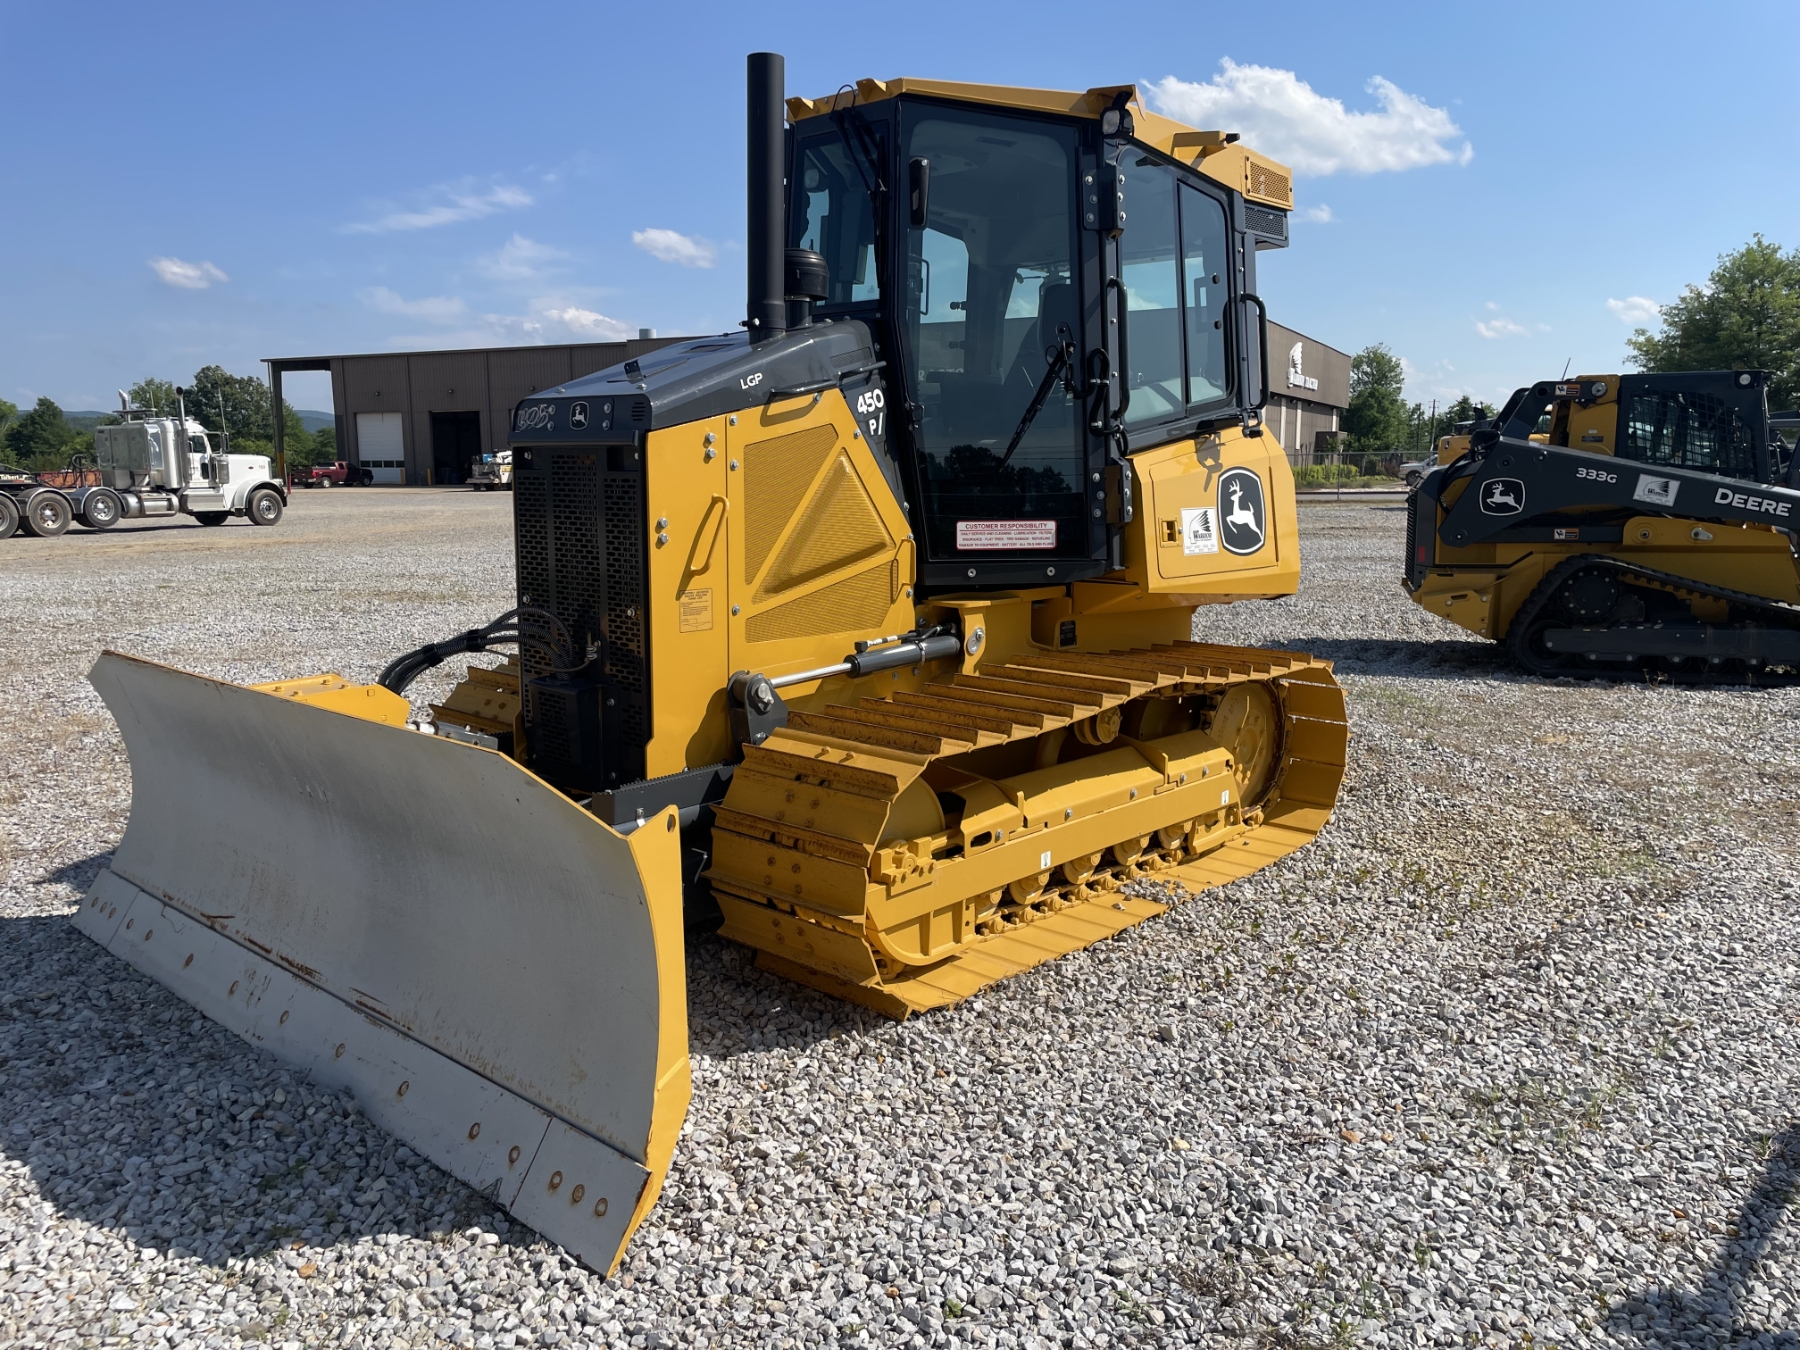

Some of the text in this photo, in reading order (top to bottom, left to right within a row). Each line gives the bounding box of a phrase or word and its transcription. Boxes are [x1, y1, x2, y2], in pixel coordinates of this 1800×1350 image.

[740, 373, 763, 390] LGP
[857, 388, 885, 414] 450
[1576, 467, 1618, 484] 333G
[1714, 488, 1792, 517] DEERE
